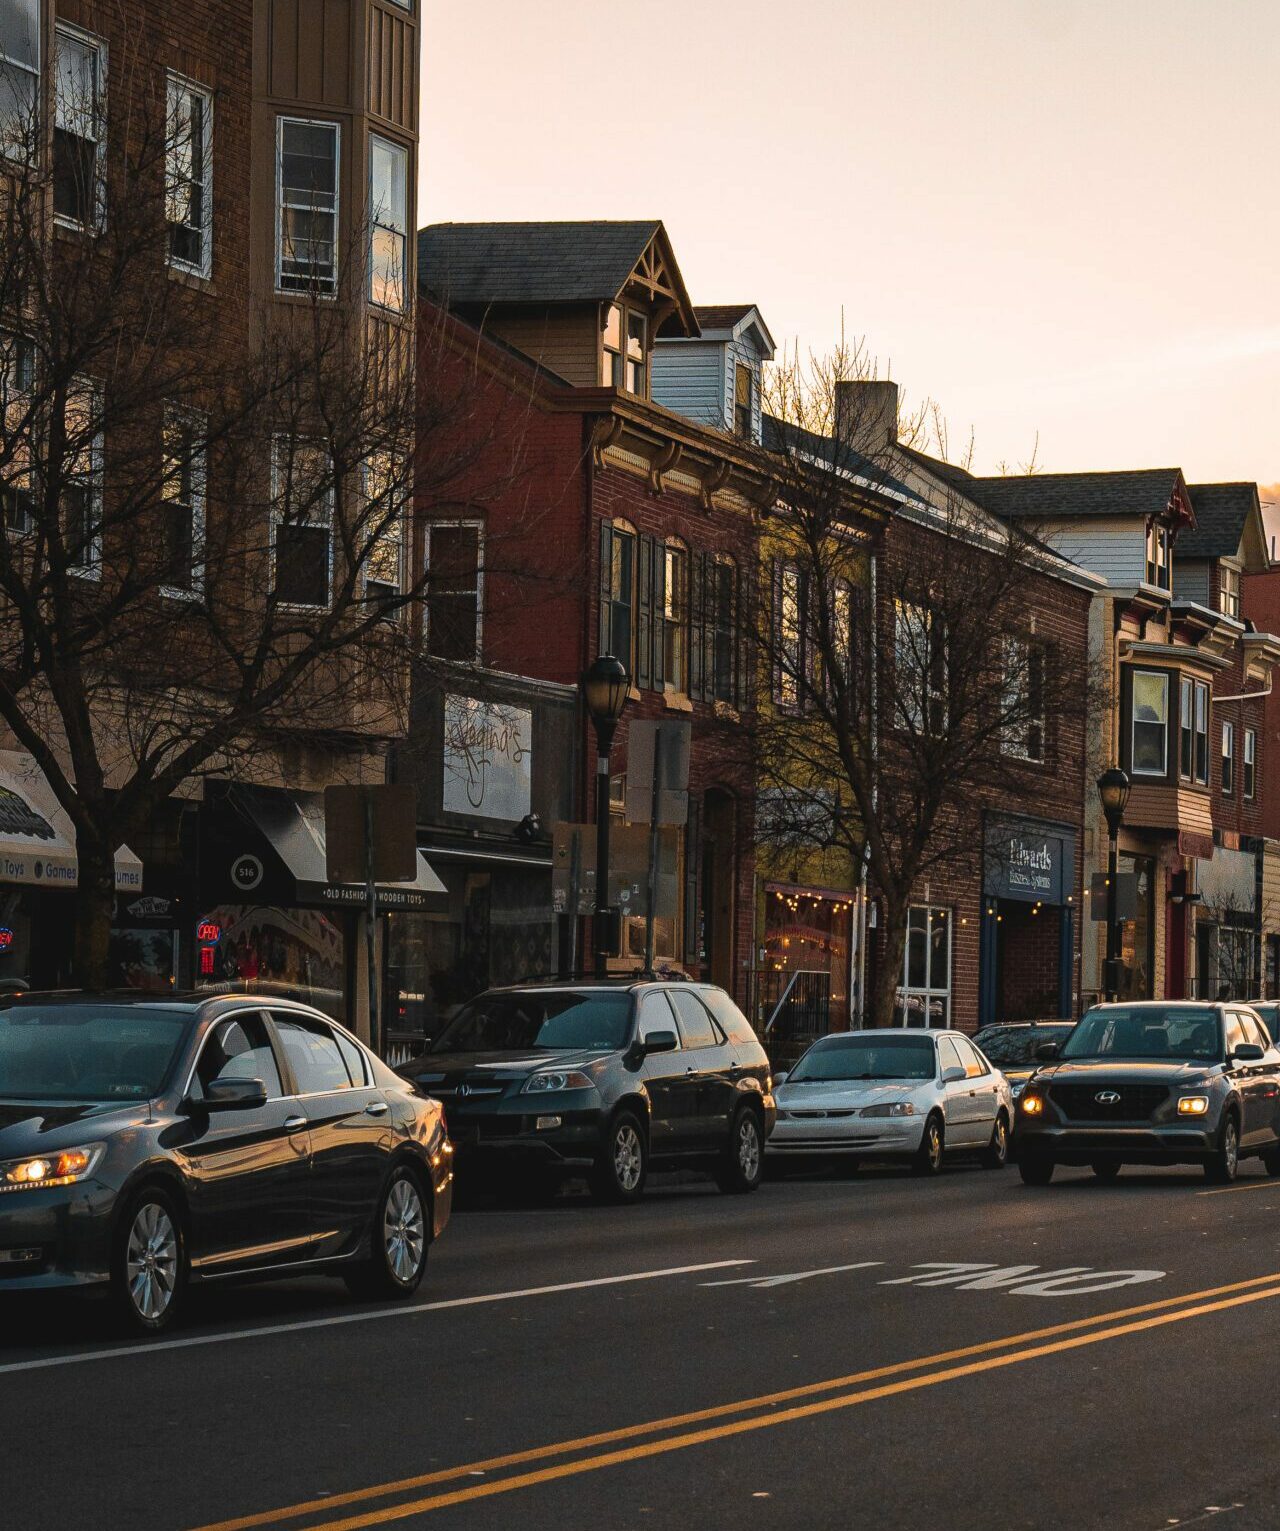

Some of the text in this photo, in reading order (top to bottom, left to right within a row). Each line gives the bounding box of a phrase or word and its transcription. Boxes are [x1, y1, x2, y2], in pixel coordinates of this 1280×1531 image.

[1008, 838, 1052, 870] Edwards
[4, 860, 24, 878] Toys
[46, 864, 76, 879] Games
[326, 888, 340, 900] OLD
[378, 893, 404, 904] WOODEN
[407, 895, 422, 906] TOYS
[198, 924, 219, 940] OPEN
